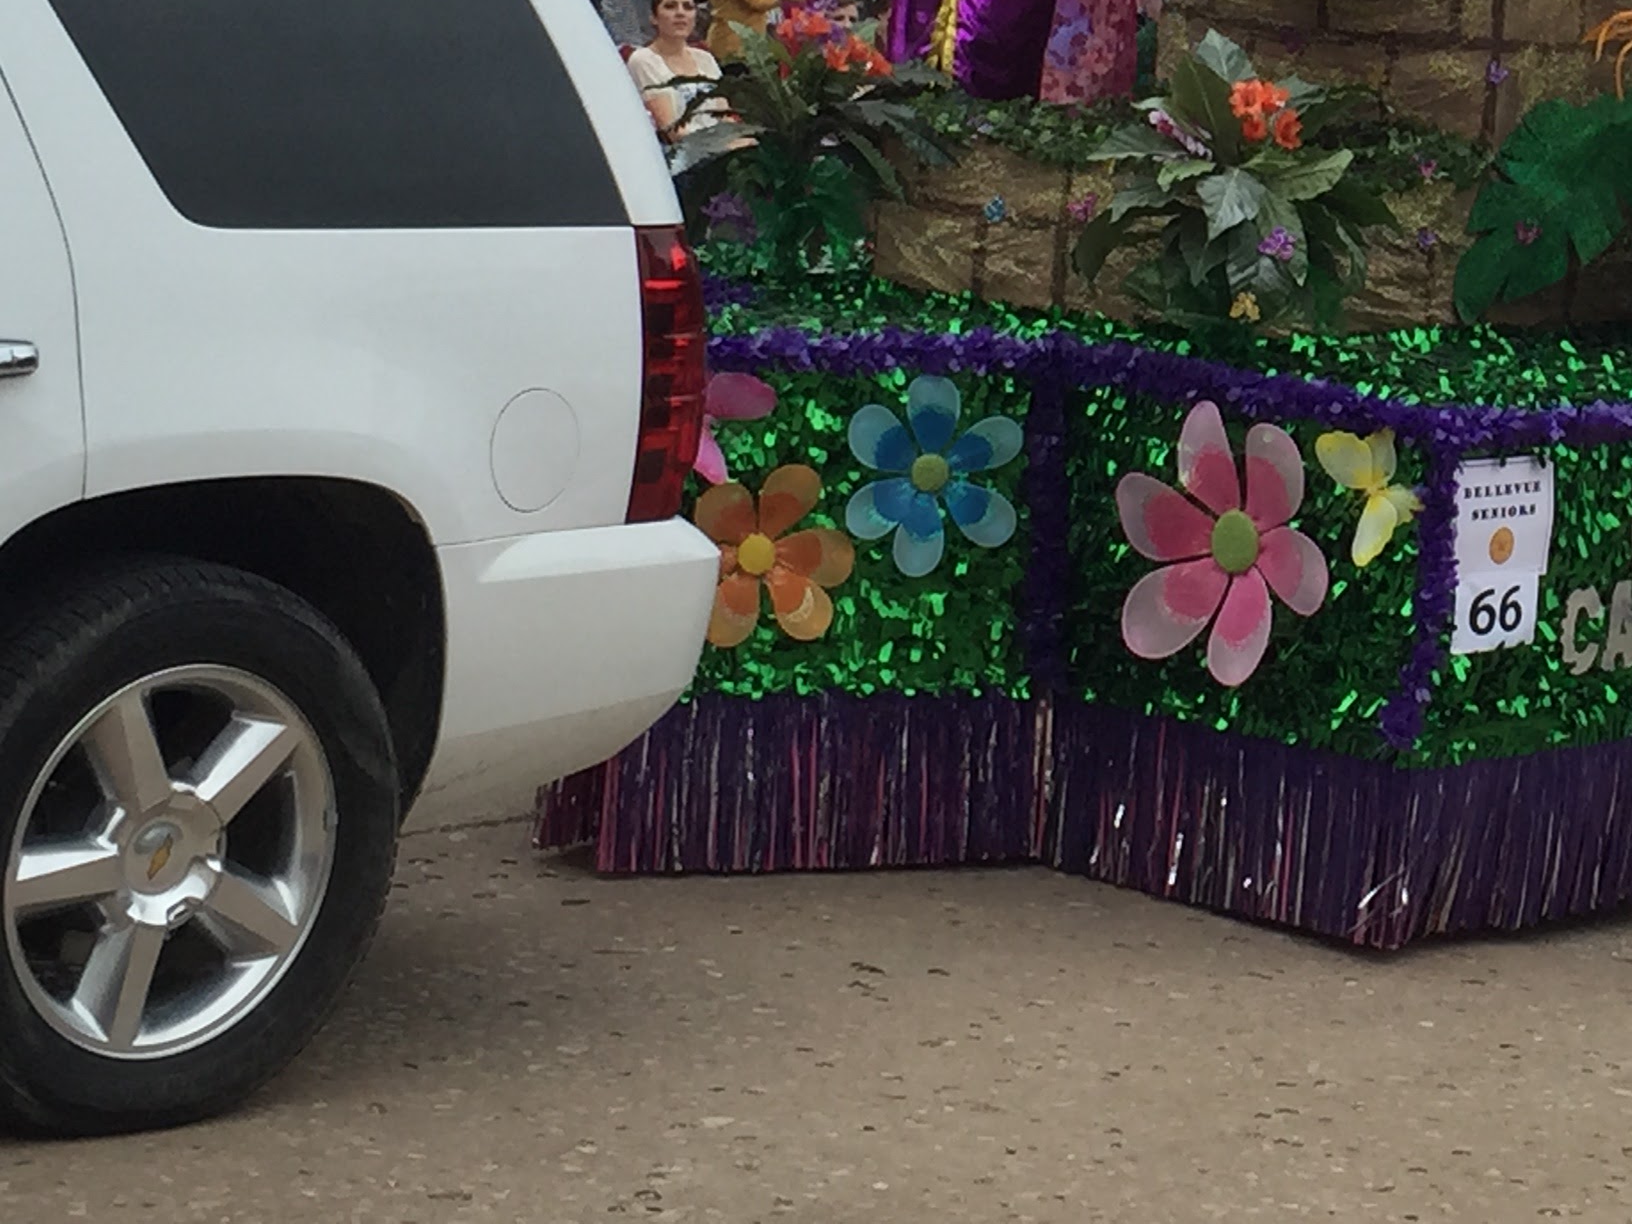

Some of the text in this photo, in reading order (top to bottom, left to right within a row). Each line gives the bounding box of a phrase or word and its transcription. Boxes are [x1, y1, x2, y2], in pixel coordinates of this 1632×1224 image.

[1464, 480, 1541, 499] BELLEVUE
[1471, 504, 1536, 520] SENIORS
[1469, 585, 1522, 635] 66
